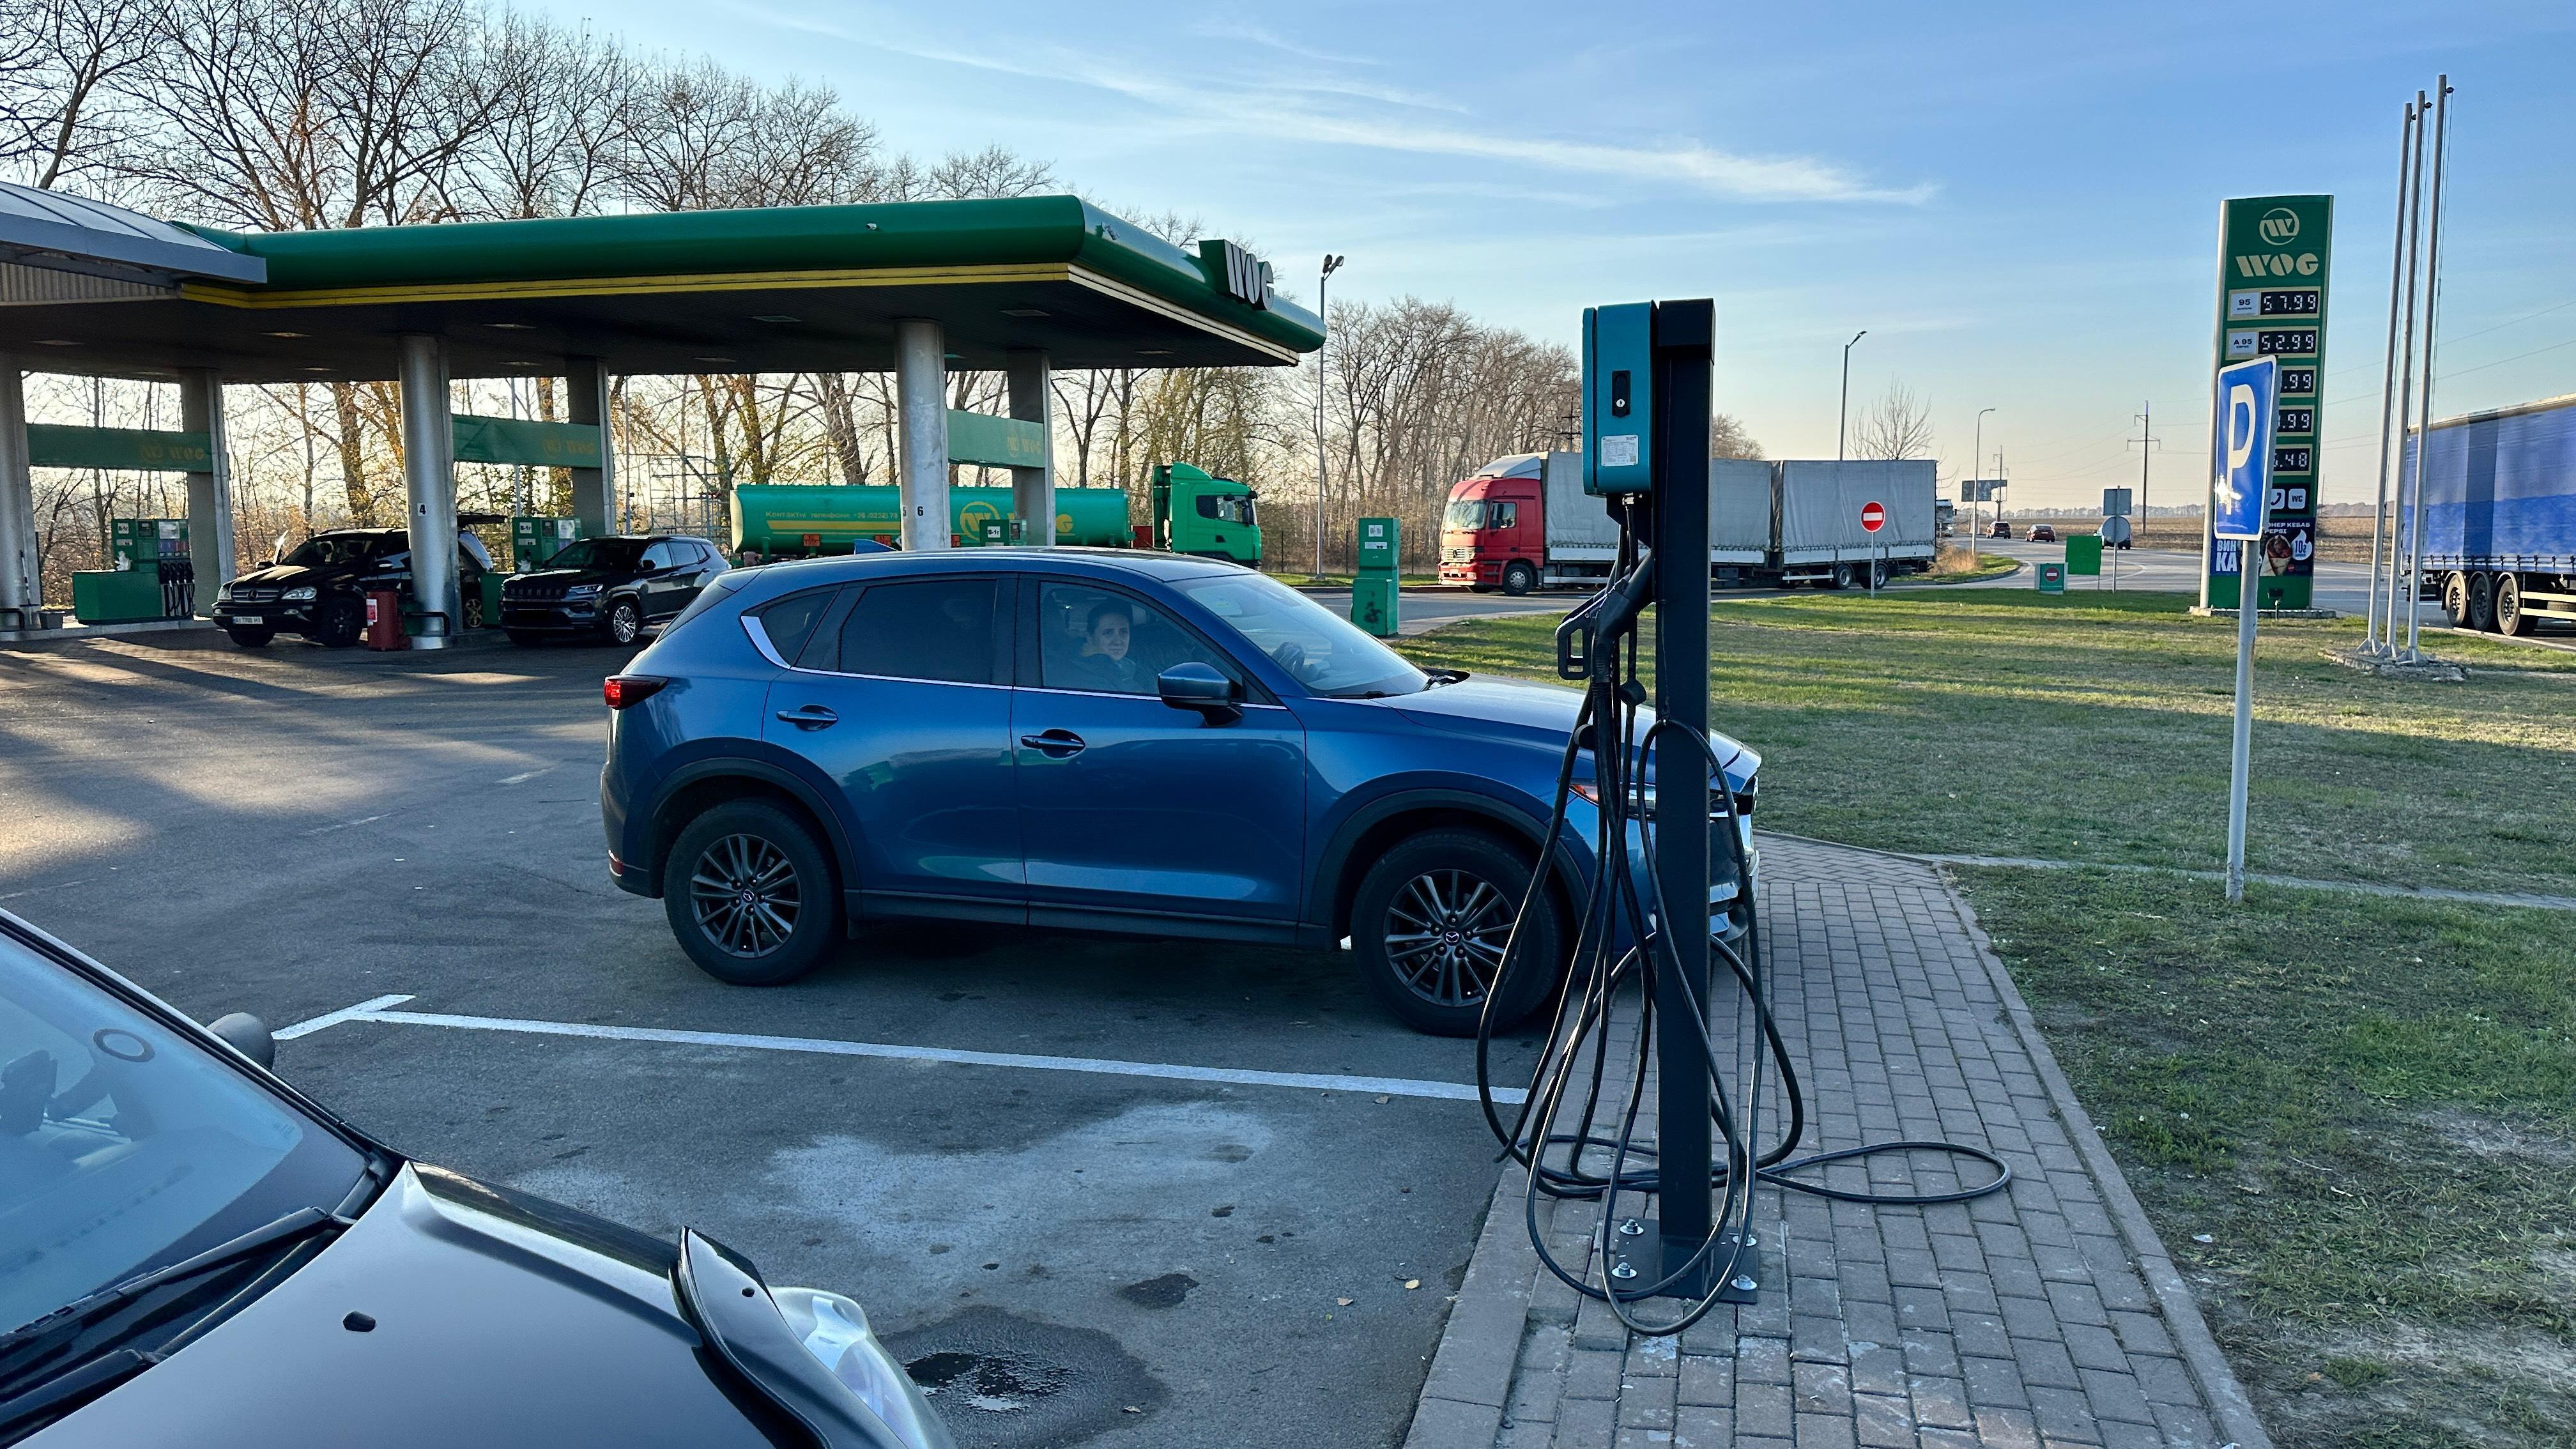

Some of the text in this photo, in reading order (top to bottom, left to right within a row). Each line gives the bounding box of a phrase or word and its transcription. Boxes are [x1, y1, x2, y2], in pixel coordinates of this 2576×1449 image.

[2235, 253, 2319, 277] WOG
[1224, 239, 1275, 310] WOG
[2264, 295, 2316, 310] 57.99
[2261, 335, 2314, 350] 52.99
[2284, 374, 2312, 389] .99
[2278, 413, 2310, 429] .99
[2226, 383, 2256, 515] P
[2274, 452, 2308, 468] .48
[419, 504, 426, 515] 4
[917, 506, 924, 517] 6
[2216, 540, 2237, 552] ВИН
[2216, 551, 2237, 572] КА
